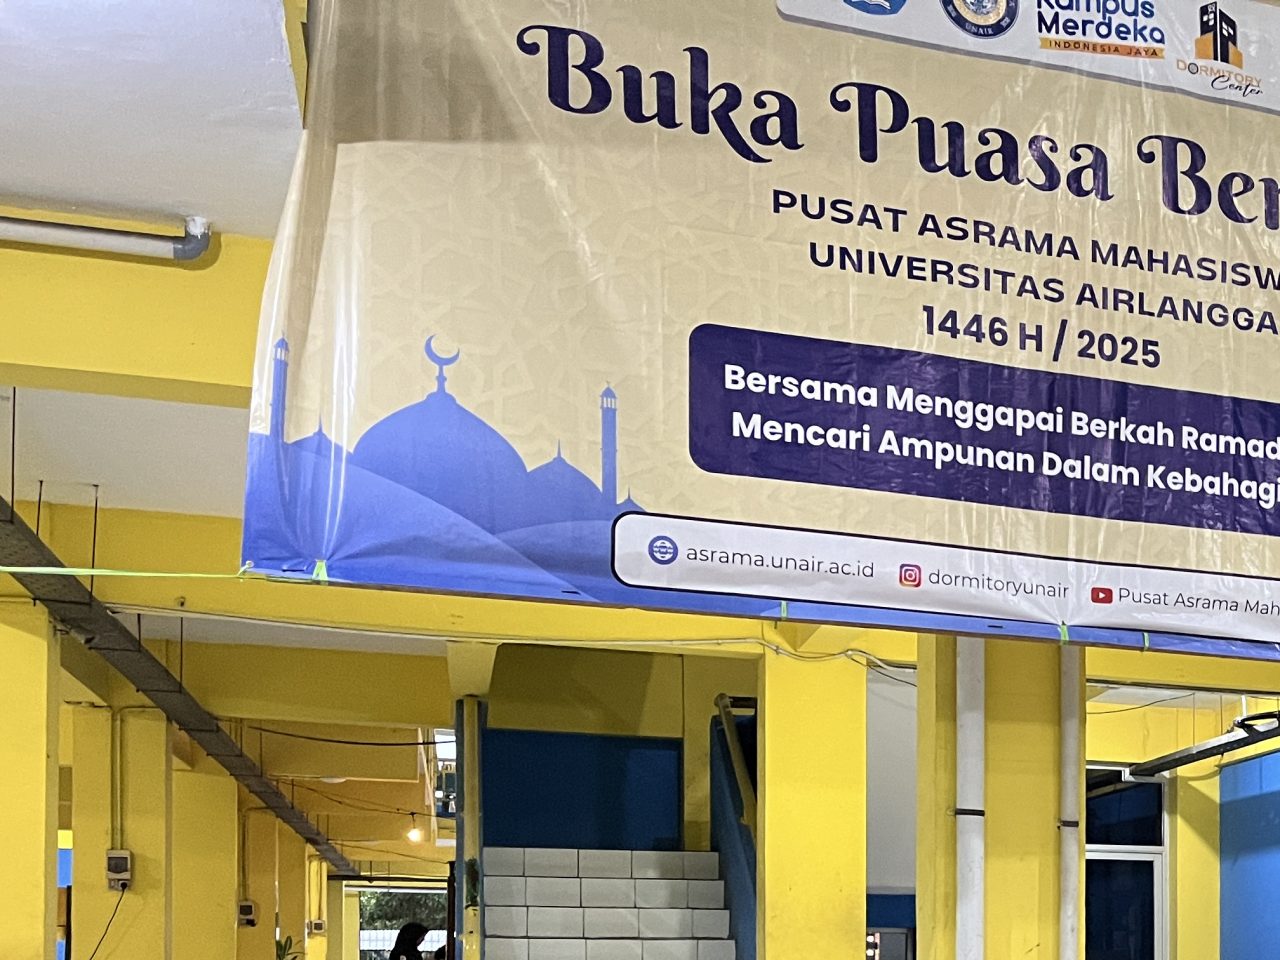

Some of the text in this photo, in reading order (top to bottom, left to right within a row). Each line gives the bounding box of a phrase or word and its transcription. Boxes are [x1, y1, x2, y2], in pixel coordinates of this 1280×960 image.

[965, 22, 994, 35] UNAIR
[1037, 10, 1165, 44] Merdeka
[1048, 40, 1158, 57] INDONESIA JAYA
[1176, 59, 1262, 88] DORMITORY
[1210, 74, 1264, 97] Center
[516, 24, 804, 163] Buka
[830, 81, 1115, 202] Puasa
[772, 189, 907, 233] PUSAT
[918, 213, 1080, 261] ASRAMA
[809, 242, 1279, 335] UNIVERSITAS AIRLANGGA
[922, 305, 1161, 368] 1446 H / 2025
[724, 363, 877, 407] Bersama
[887, 385, 1063, 436] Menggapai
[1071, 411, 1174, 448] Berkah
[732, 411, 870, 452] Mencari
[878, 430, 1034, 473] Ampunan
[1042, 452, 1139, 486] Dalam
[686, 545, 874, 578] asrama.unair.ac.id
[928, 569, 1069, 599] dormitoryunair
[1118, 587, 1168, 607] Pusat
[1174, 593, 1239, 613] Asrama
